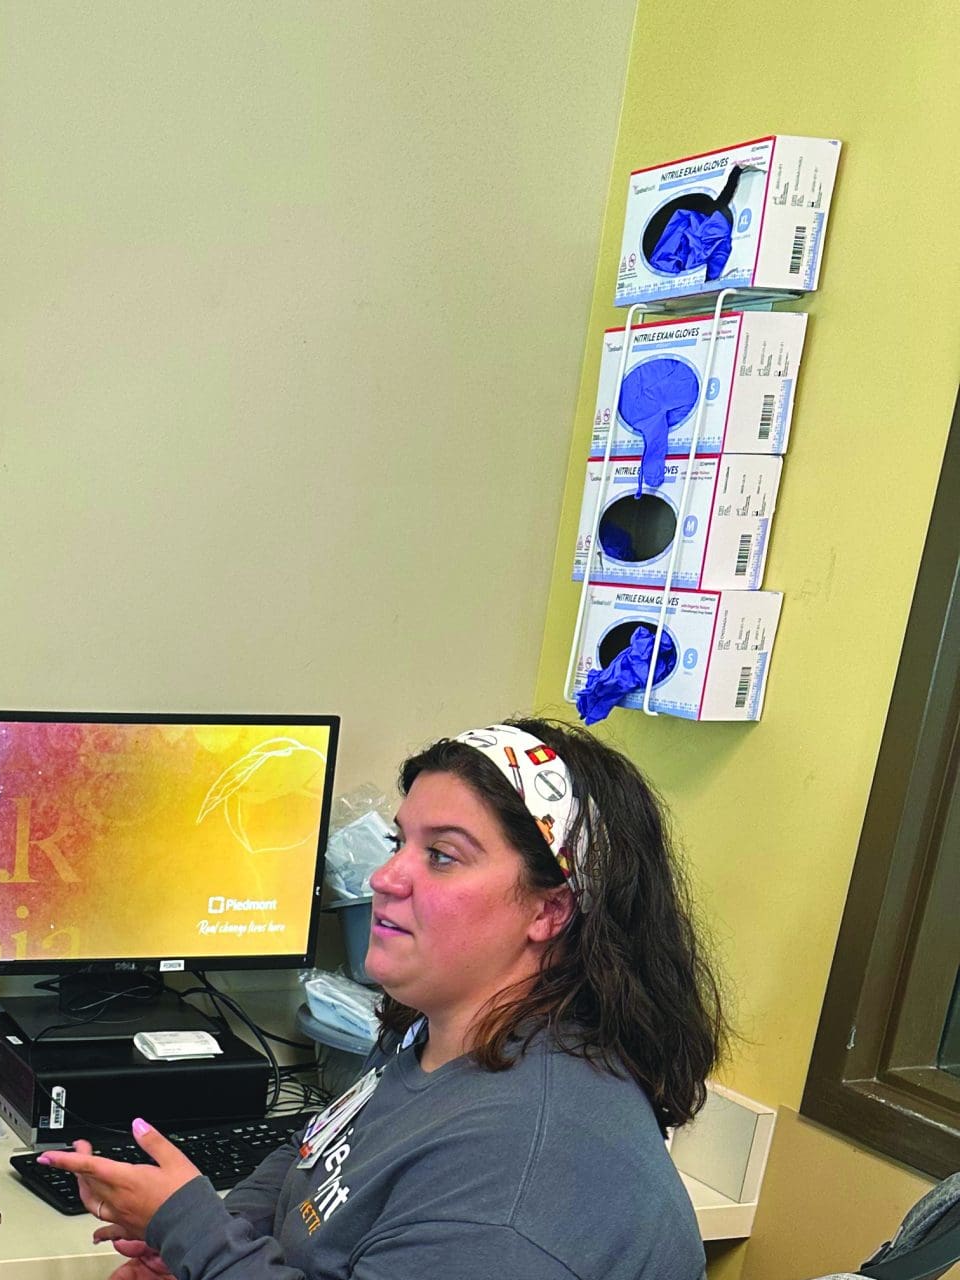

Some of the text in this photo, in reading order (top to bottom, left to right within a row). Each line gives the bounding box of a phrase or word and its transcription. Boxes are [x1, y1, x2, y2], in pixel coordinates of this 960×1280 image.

[661, 169, 683, 181] NITRILE
[684, 163, 703, 176] EXAM
[704, 158, 729, 171] GLOVES
[633, 332, 656, 343] NITRILE
[656, 330, 675, 340] EXAM
[675, 328, 700, 339] GLOVES
[615, 466, 636, 475] NITRILE
[664, 466, 678, 474] OVES
[616, 594, 679, 606] NITRILE EXAM GLVES
[226, 898, 277, 911] Piedmont
